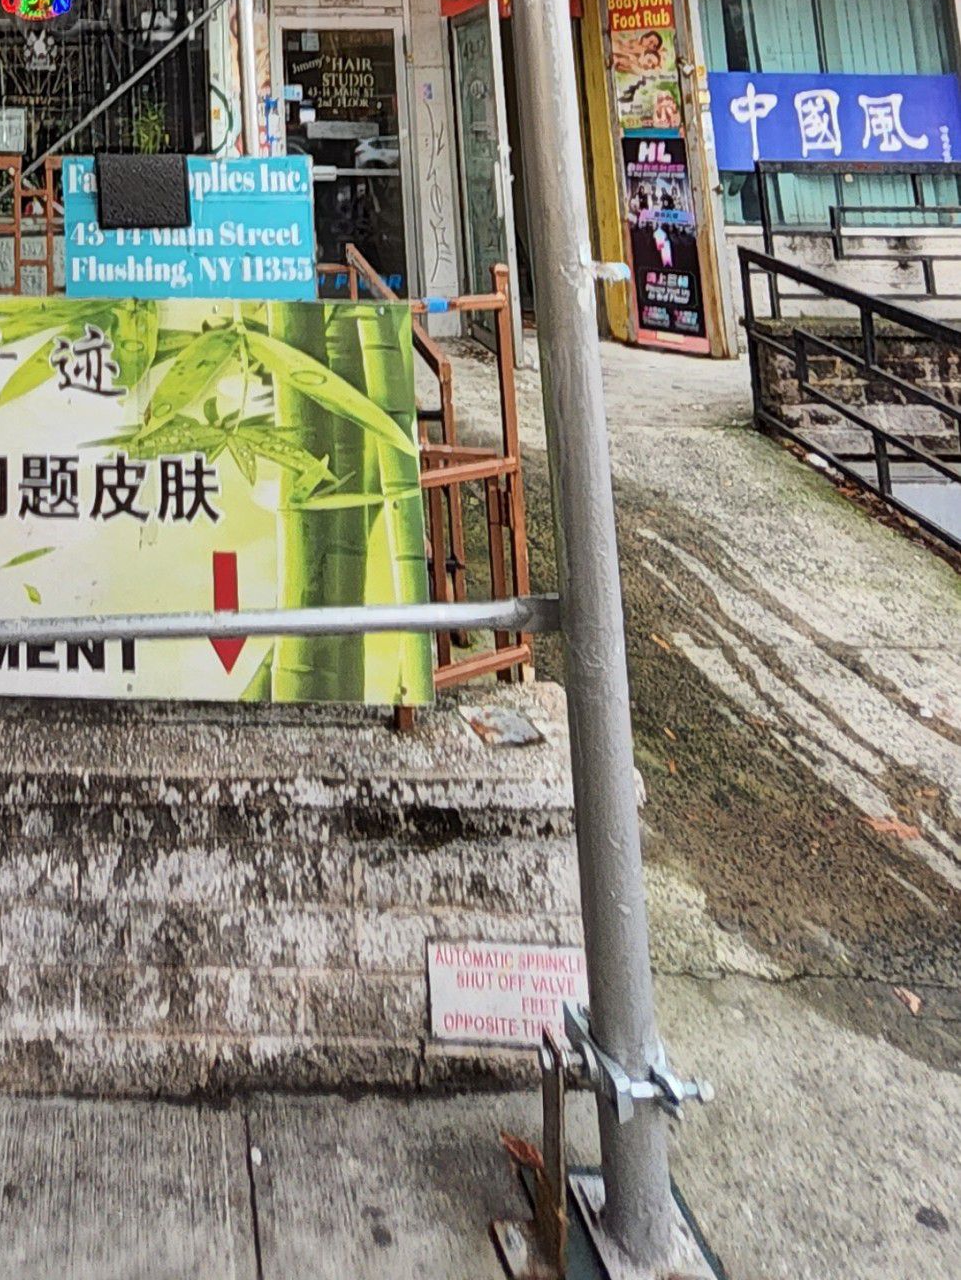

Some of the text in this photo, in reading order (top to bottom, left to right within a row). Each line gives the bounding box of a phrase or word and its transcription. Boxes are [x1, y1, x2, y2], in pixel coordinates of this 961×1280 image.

[612, 8, 670, 30] Foot Rub
[332, 57, 373, 72] HAIR
[322, 73, 374, 88] STUDIO
[730, 81, 929, 161] 中國風
[638, 141, 672, 164] HL
[260, 163, 308, 194] Inc.
[70, 221, 302, 247] 43-14 Main Street
[71, 255, 194, 289] Flushing,
[198, 256, 236, 282] NY
[436, 948, 513, 970] AUTOMATIC
[456, 972, 576, 997] SHUT OFF VALVE
[443, 1010, 518, 1037] OPPOSITE
